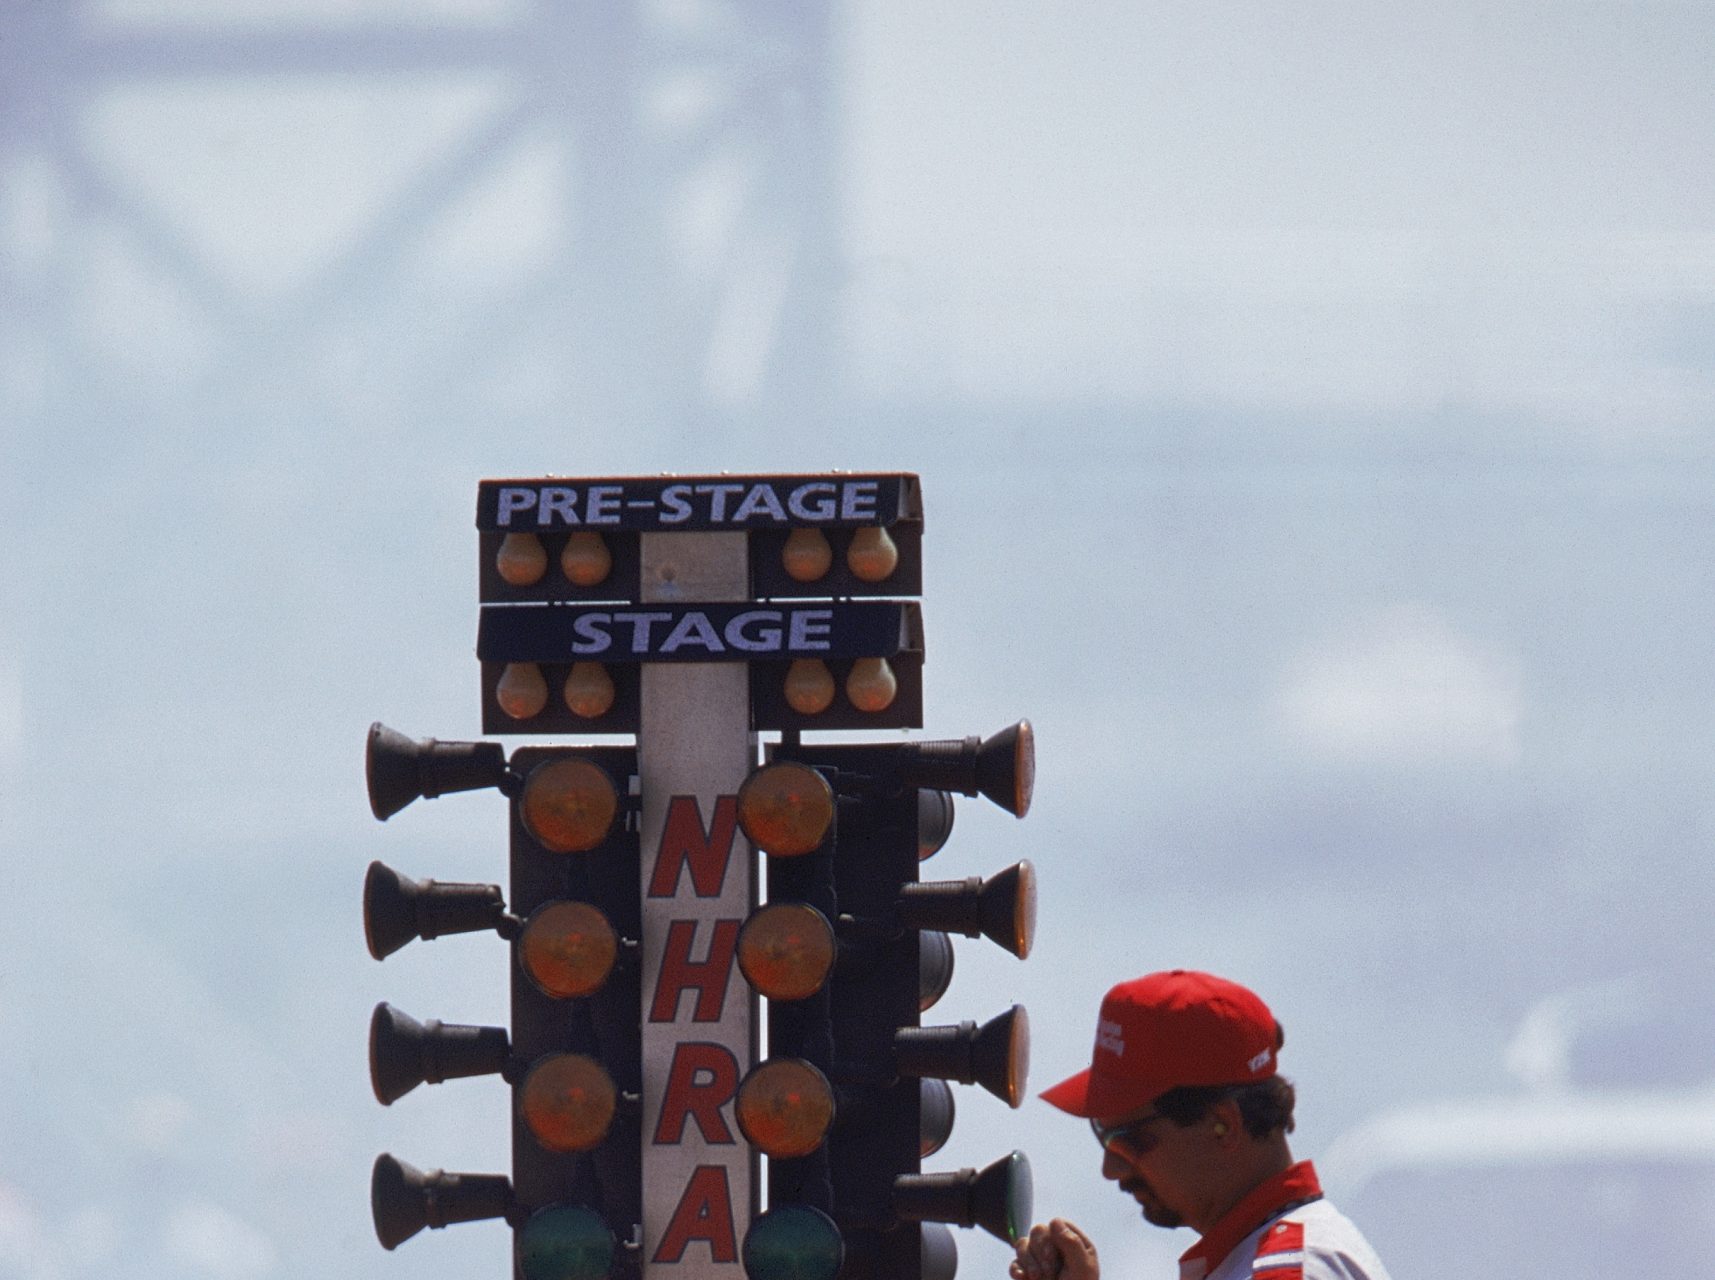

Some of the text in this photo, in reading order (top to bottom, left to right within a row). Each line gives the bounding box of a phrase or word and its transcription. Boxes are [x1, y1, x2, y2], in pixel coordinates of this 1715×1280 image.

[496, 481, 878, 526] PRE-STAGE
[571, 609, 834, 654] STAGE
[646, 793, 743, 1265] NHRA
